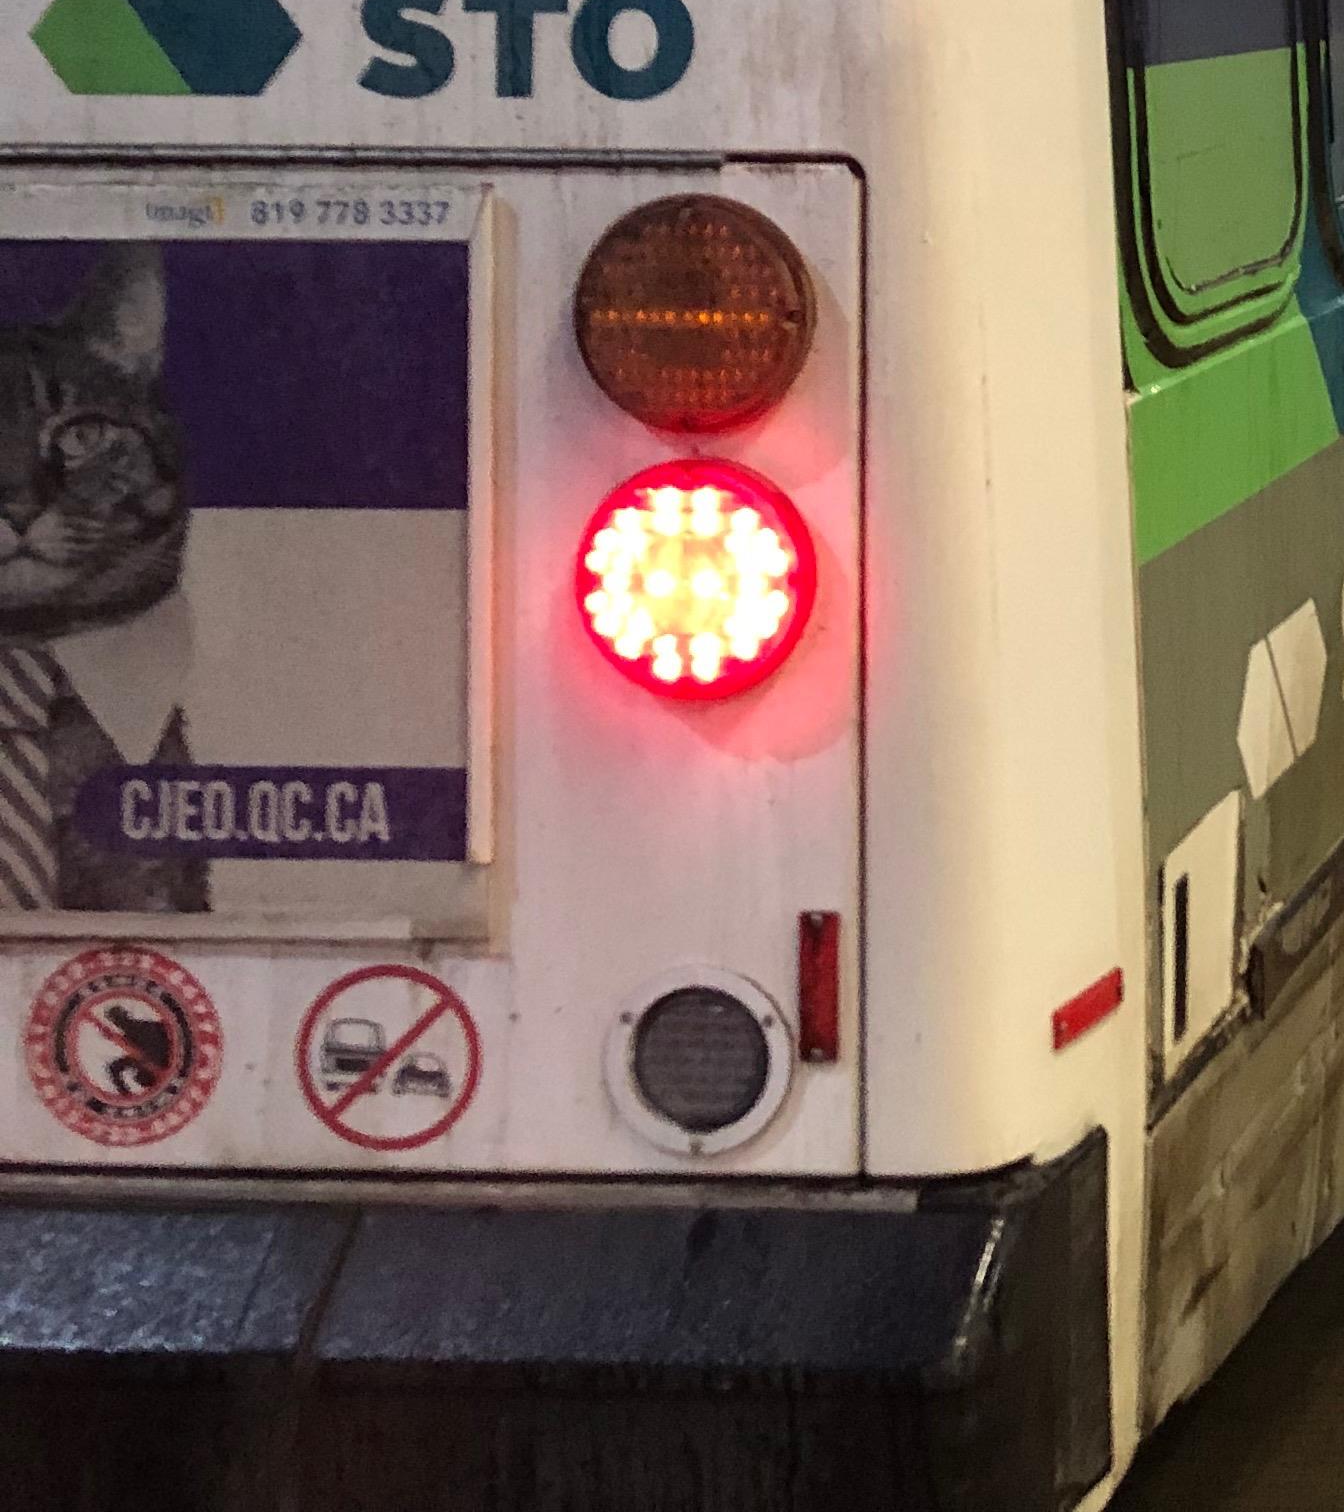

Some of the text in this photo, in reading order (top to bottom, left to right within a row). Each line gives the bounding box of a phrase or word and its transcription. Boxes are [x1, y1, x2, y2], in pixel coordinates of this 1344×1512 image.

[250, 199, 305, 227] 819
[315, 198, 371, 226] 778
[379, 199, 452, 227] 3337
